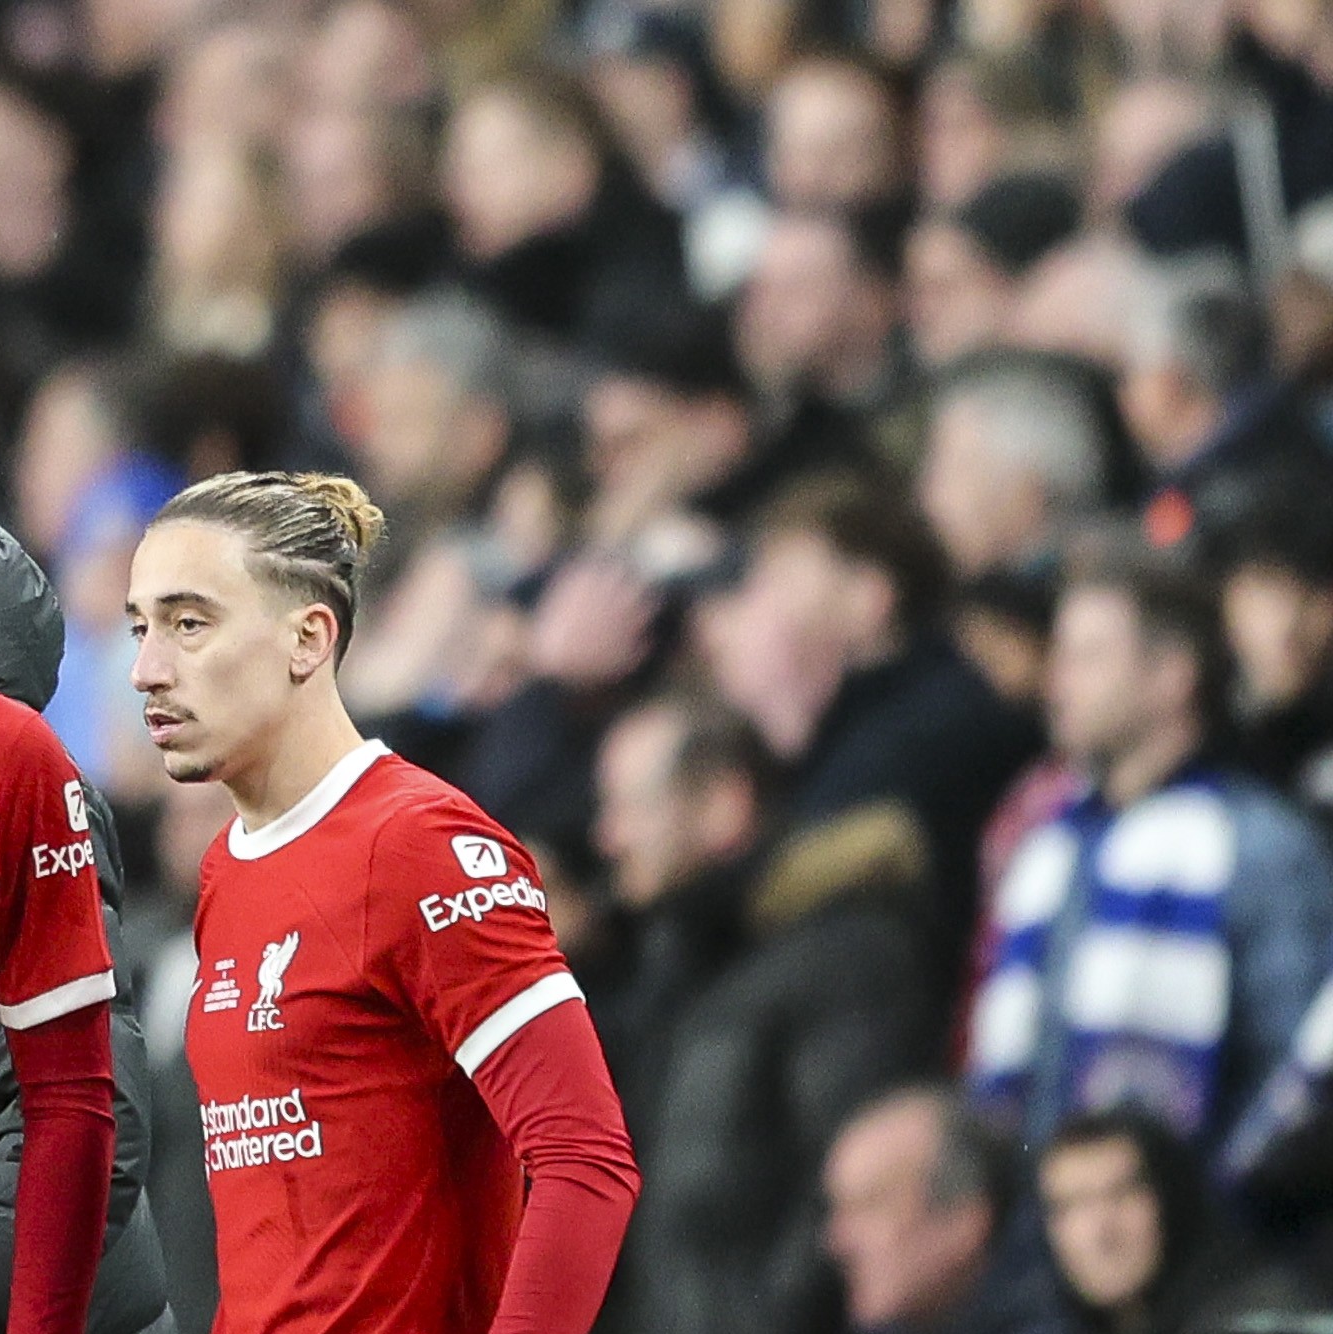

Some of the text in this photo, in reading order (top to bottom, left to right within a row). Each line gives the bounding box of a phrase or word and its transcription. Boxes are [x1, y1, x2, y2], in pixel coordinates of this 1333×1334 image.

[32, 839, 95, 879] Expe
[207, 1088, 307, 1136] standard
[210, 1120, 322, 1171] chartered
